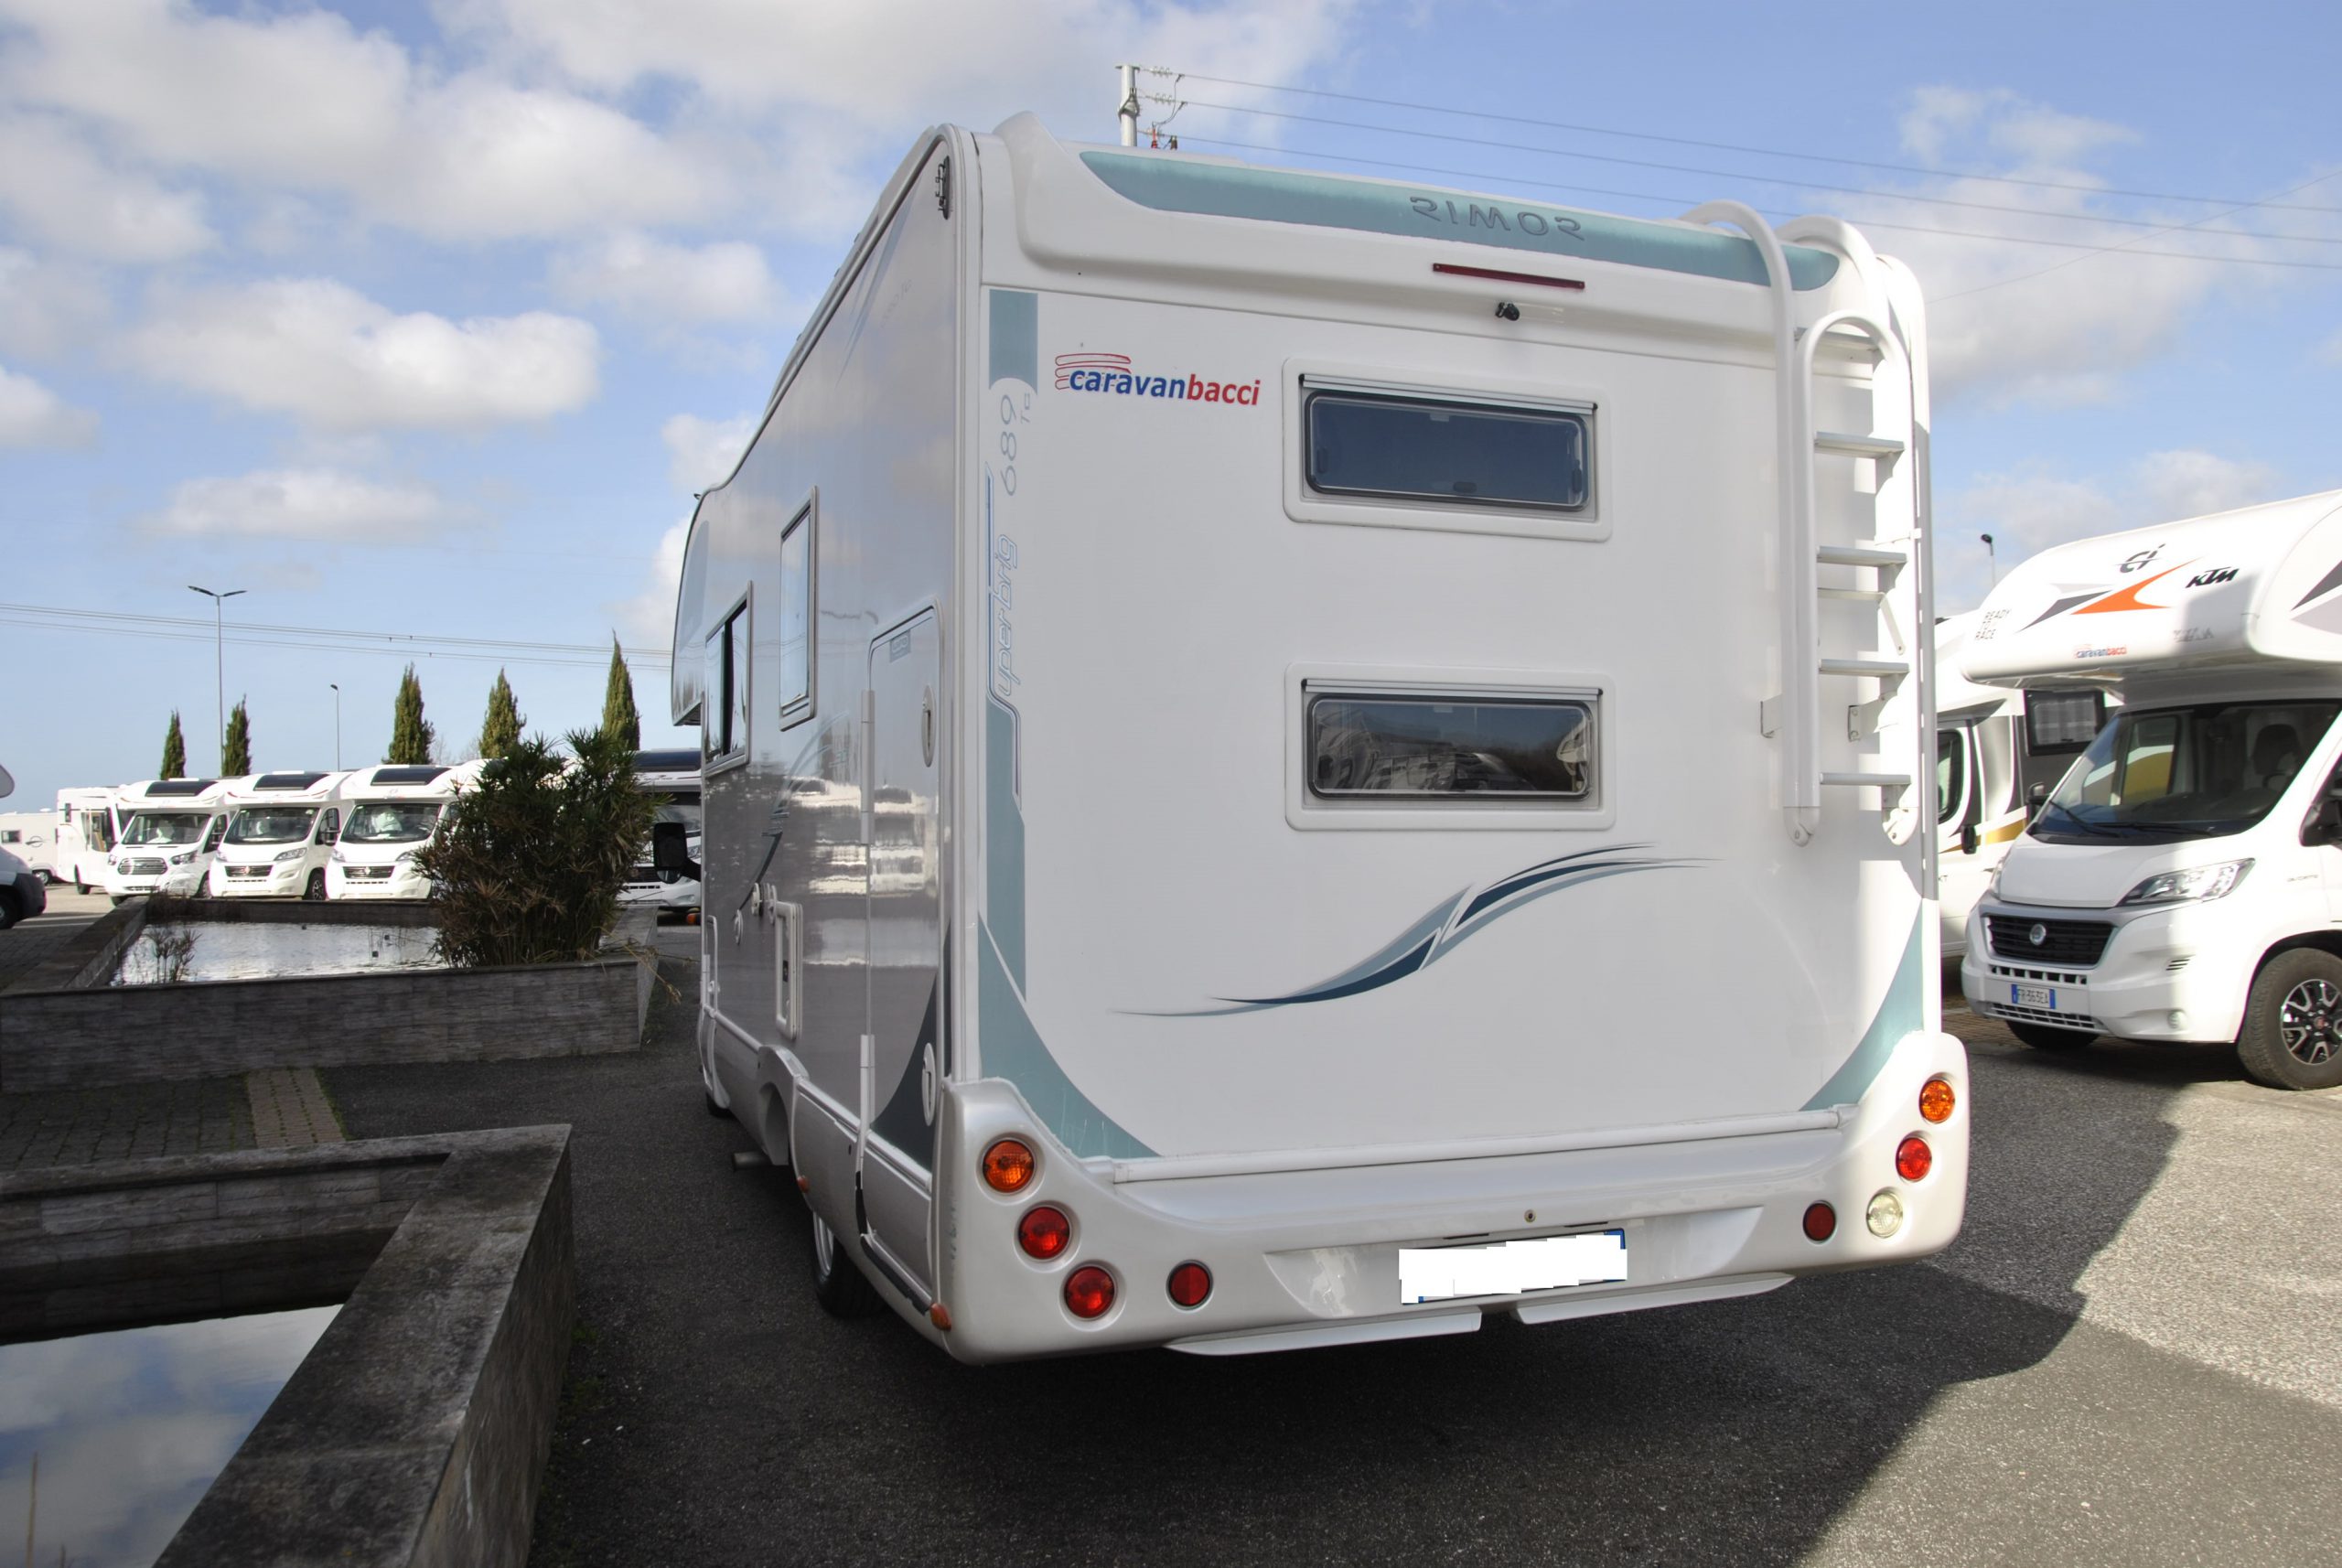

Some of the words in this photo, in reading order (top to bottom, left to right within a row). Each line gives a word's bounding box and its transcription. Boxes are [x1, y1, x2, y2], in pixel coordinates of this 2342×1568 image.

[1410, 196, 1585, 241] RIMOR
[1069, 370, 1261, 405] caravanbacci
[1000, 394, 1016, 496] 689
[2185, 566, 2240, 588] KTM
[1984, 608, 2012, 620] READY
[1974, 628, 1996, 640] RACE
